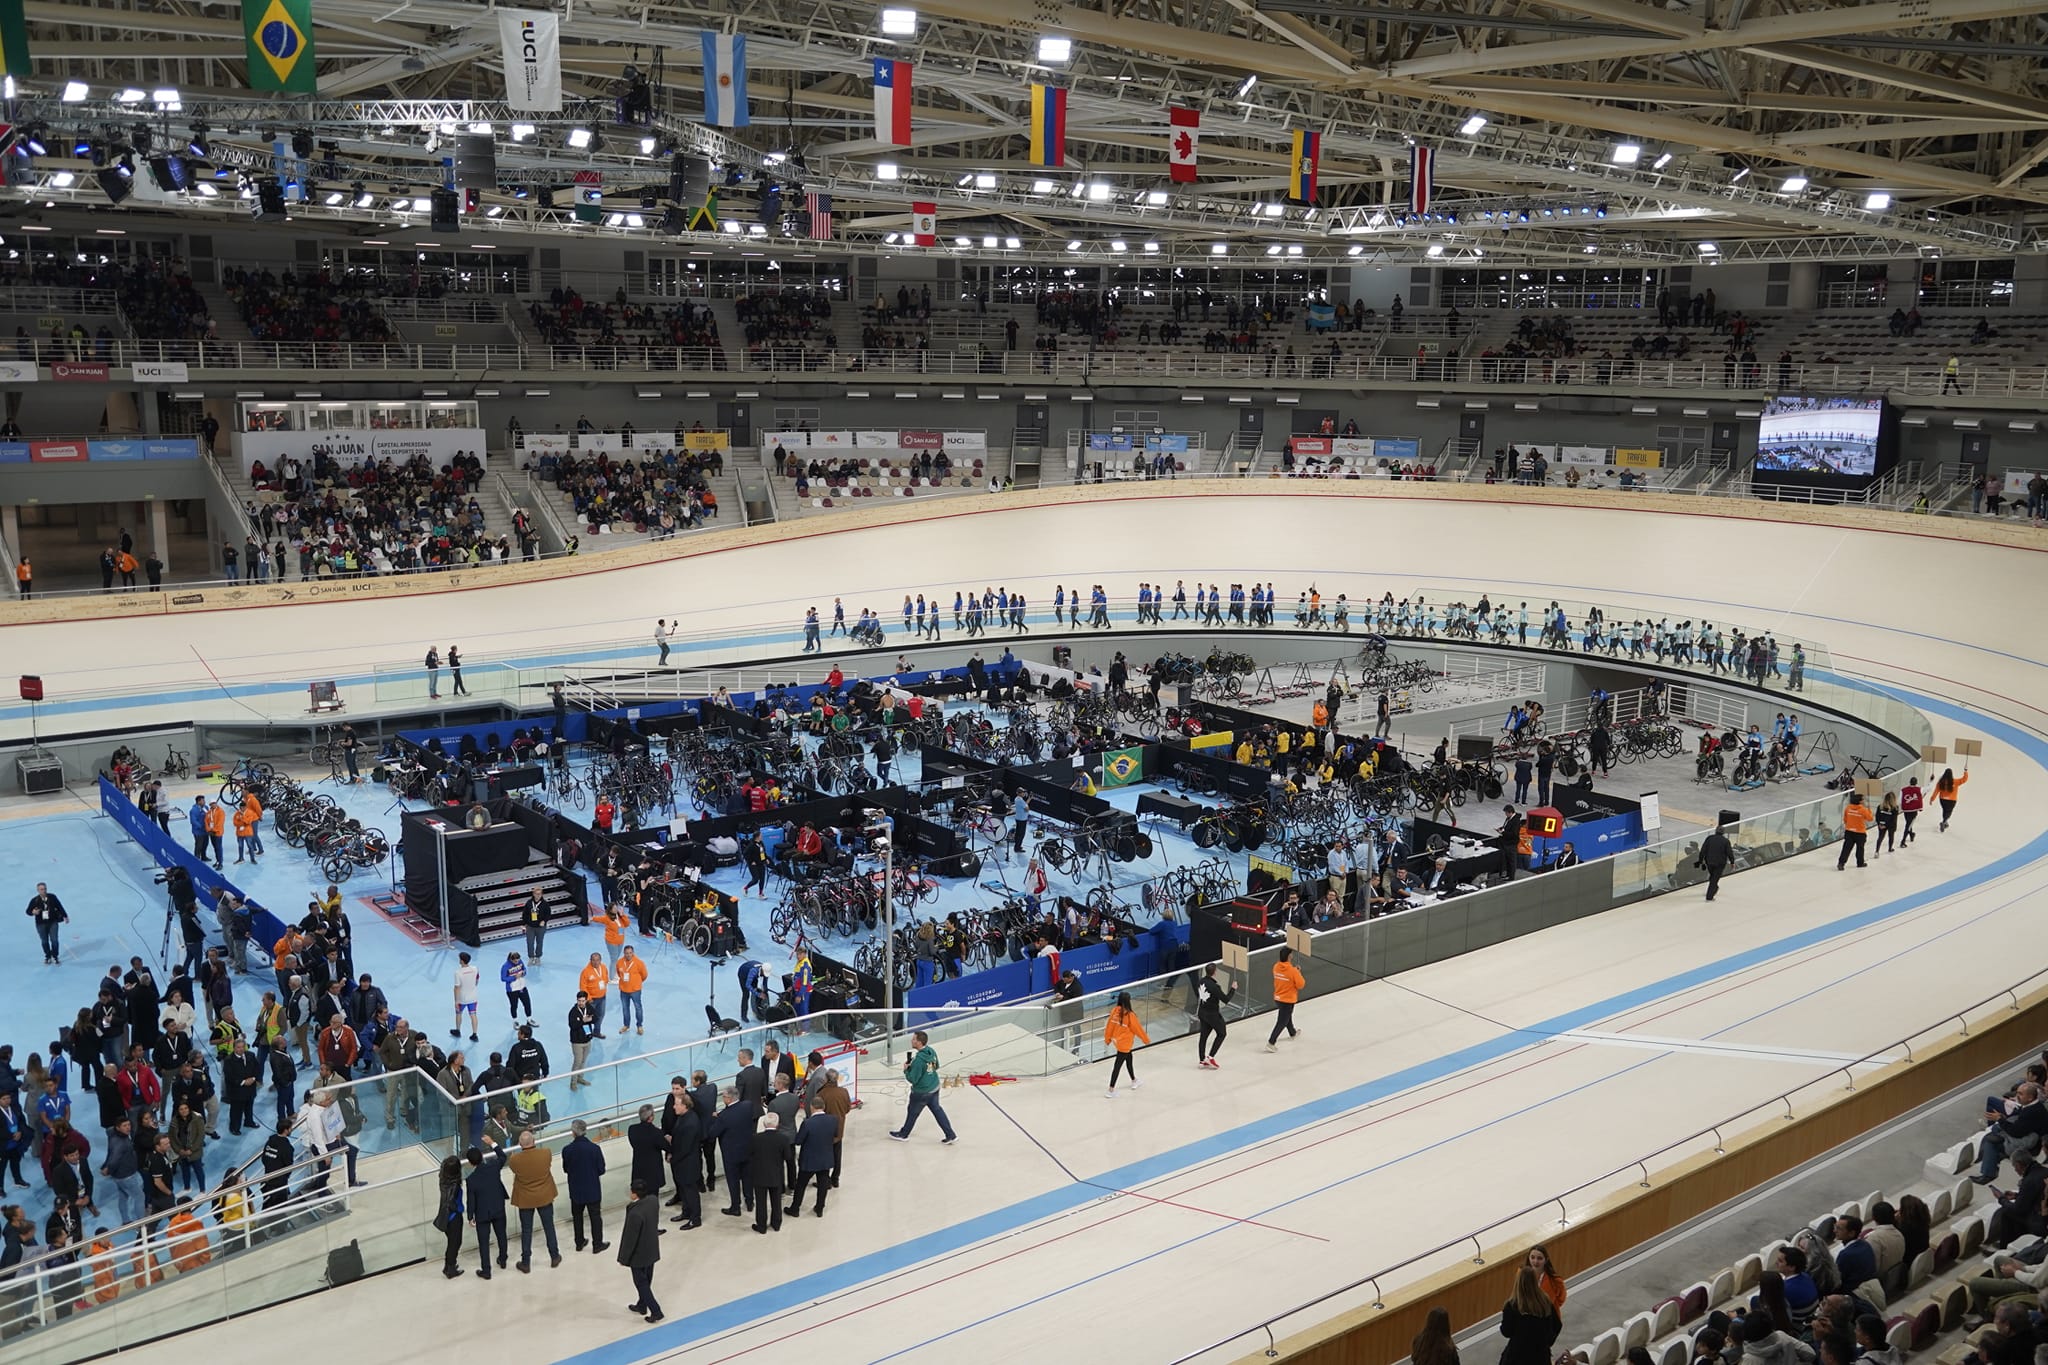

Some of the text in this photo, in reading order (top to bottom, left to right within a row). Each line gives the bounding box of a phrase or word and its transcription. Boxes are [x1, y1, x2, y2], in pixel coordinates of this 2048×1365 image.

[522, 29, 537, 63] UCI
[142, 368, 161, 376] UCI
[336, 443, 365, 455] JUAN
